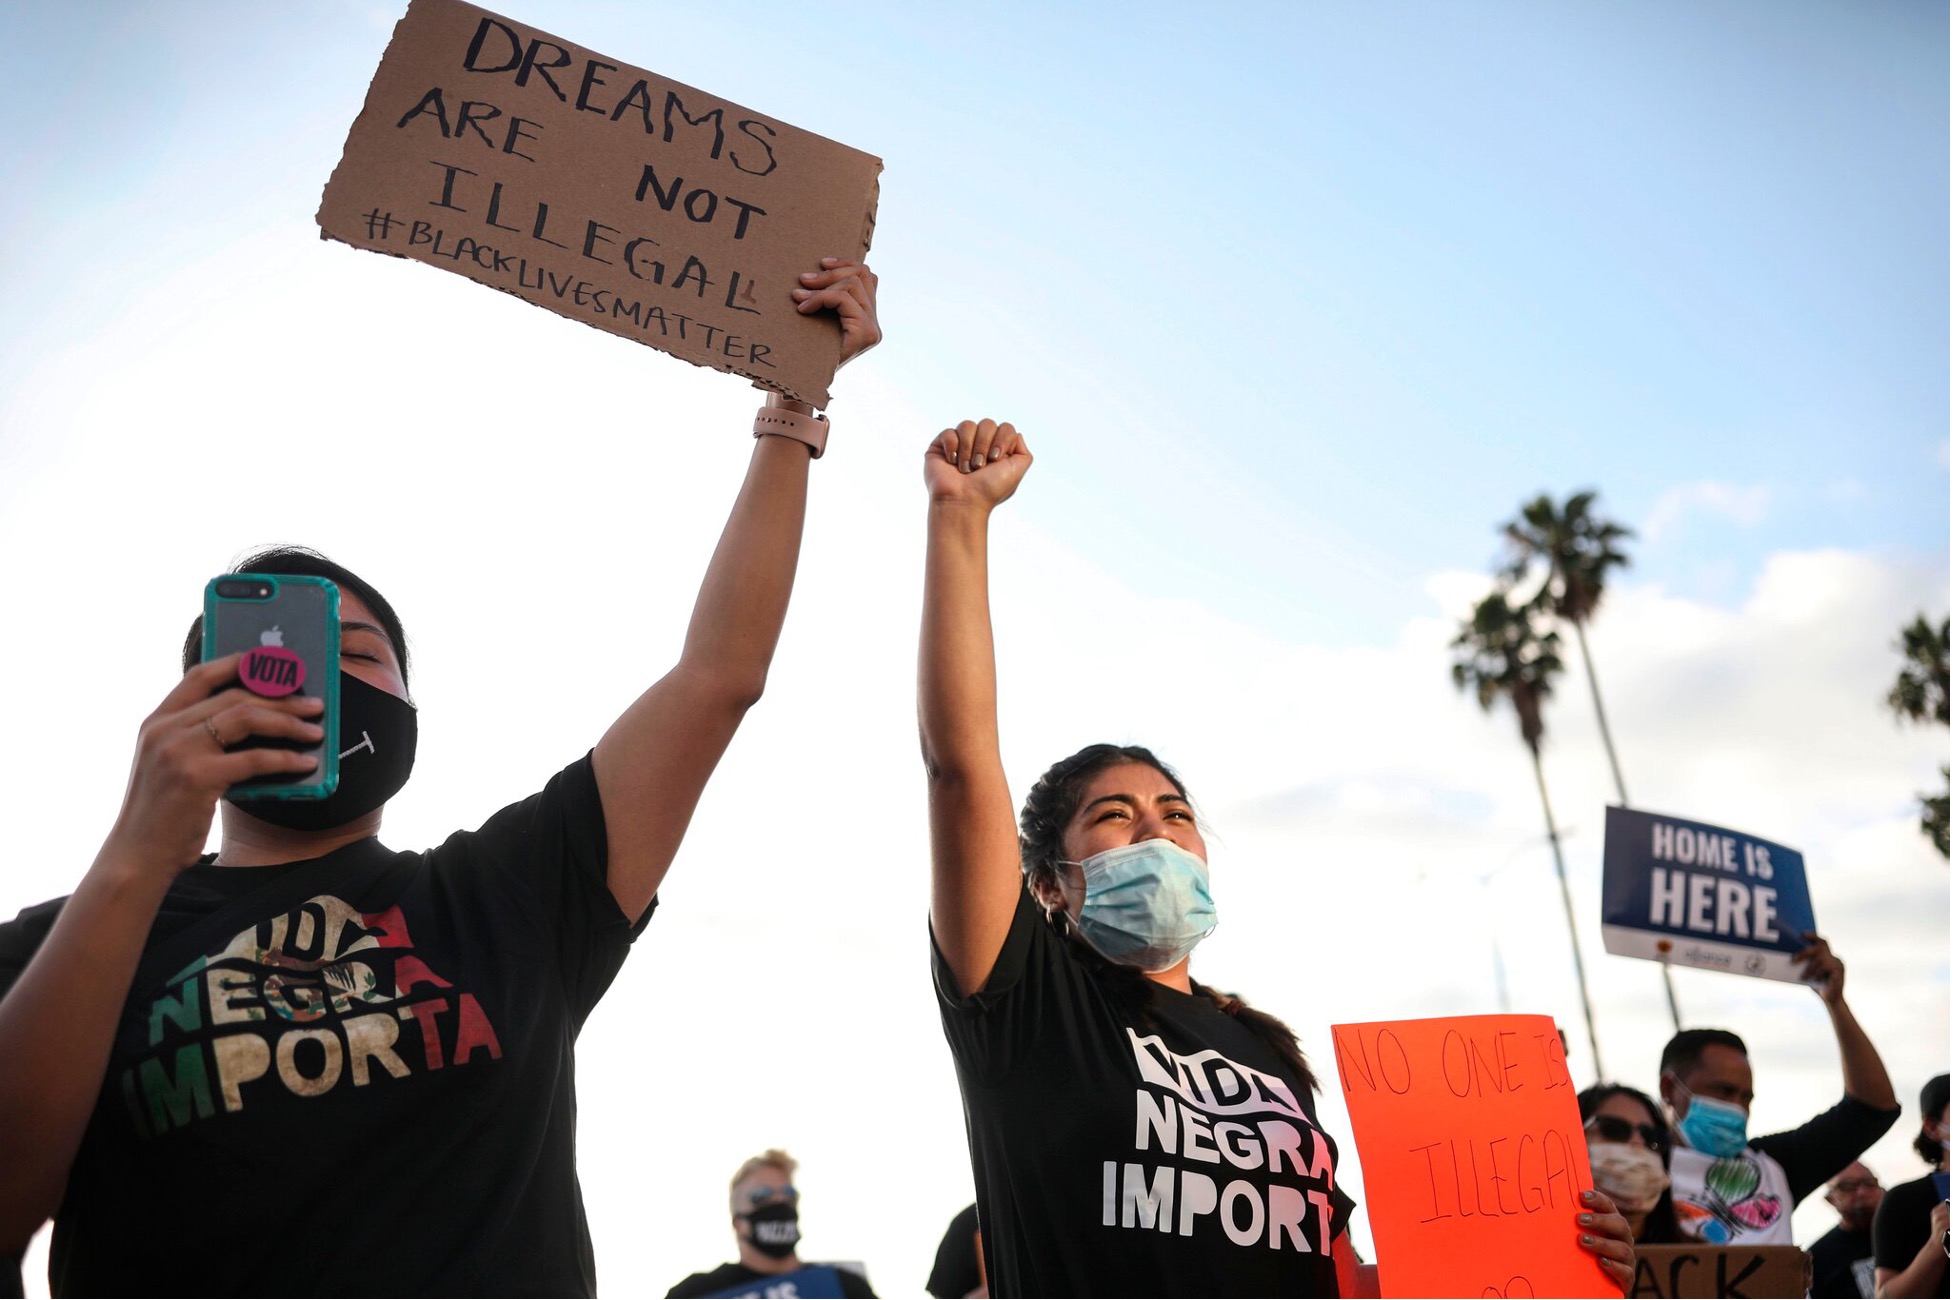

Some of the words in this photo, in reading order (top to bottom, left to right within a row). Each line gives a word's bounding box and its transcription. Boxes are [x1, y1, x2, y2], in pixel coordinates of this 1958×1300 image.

[463, 17, 778, 176] DREAMS
[397, 87, 544, 162] ARE
[635, 164, 767, 240] NOT
[363, 207, 777, 368] #BLACKLIVESMATTER
[429, 161, 761, 315] ILLEGAL
[249, 653, 298, 688] VOTA
[1652, 822, 1739, 873] HOME
[1744, 842, 1773, 880] IS
[1650, 867, 1780, 944] HERE
[149, 955, 454, 1047] NEGRA
[122, 992, 503, 1141] IMPORTA
[1334, 1028, 1411, 1095] NO
[1442, 1029, 1524, 1098] ONE
[1533, 1033, 1569, 1091] IS
[1135, 1088, 1334, 1192] NEGRA
[1102, 1160, 1333, 1257] IMPORT
